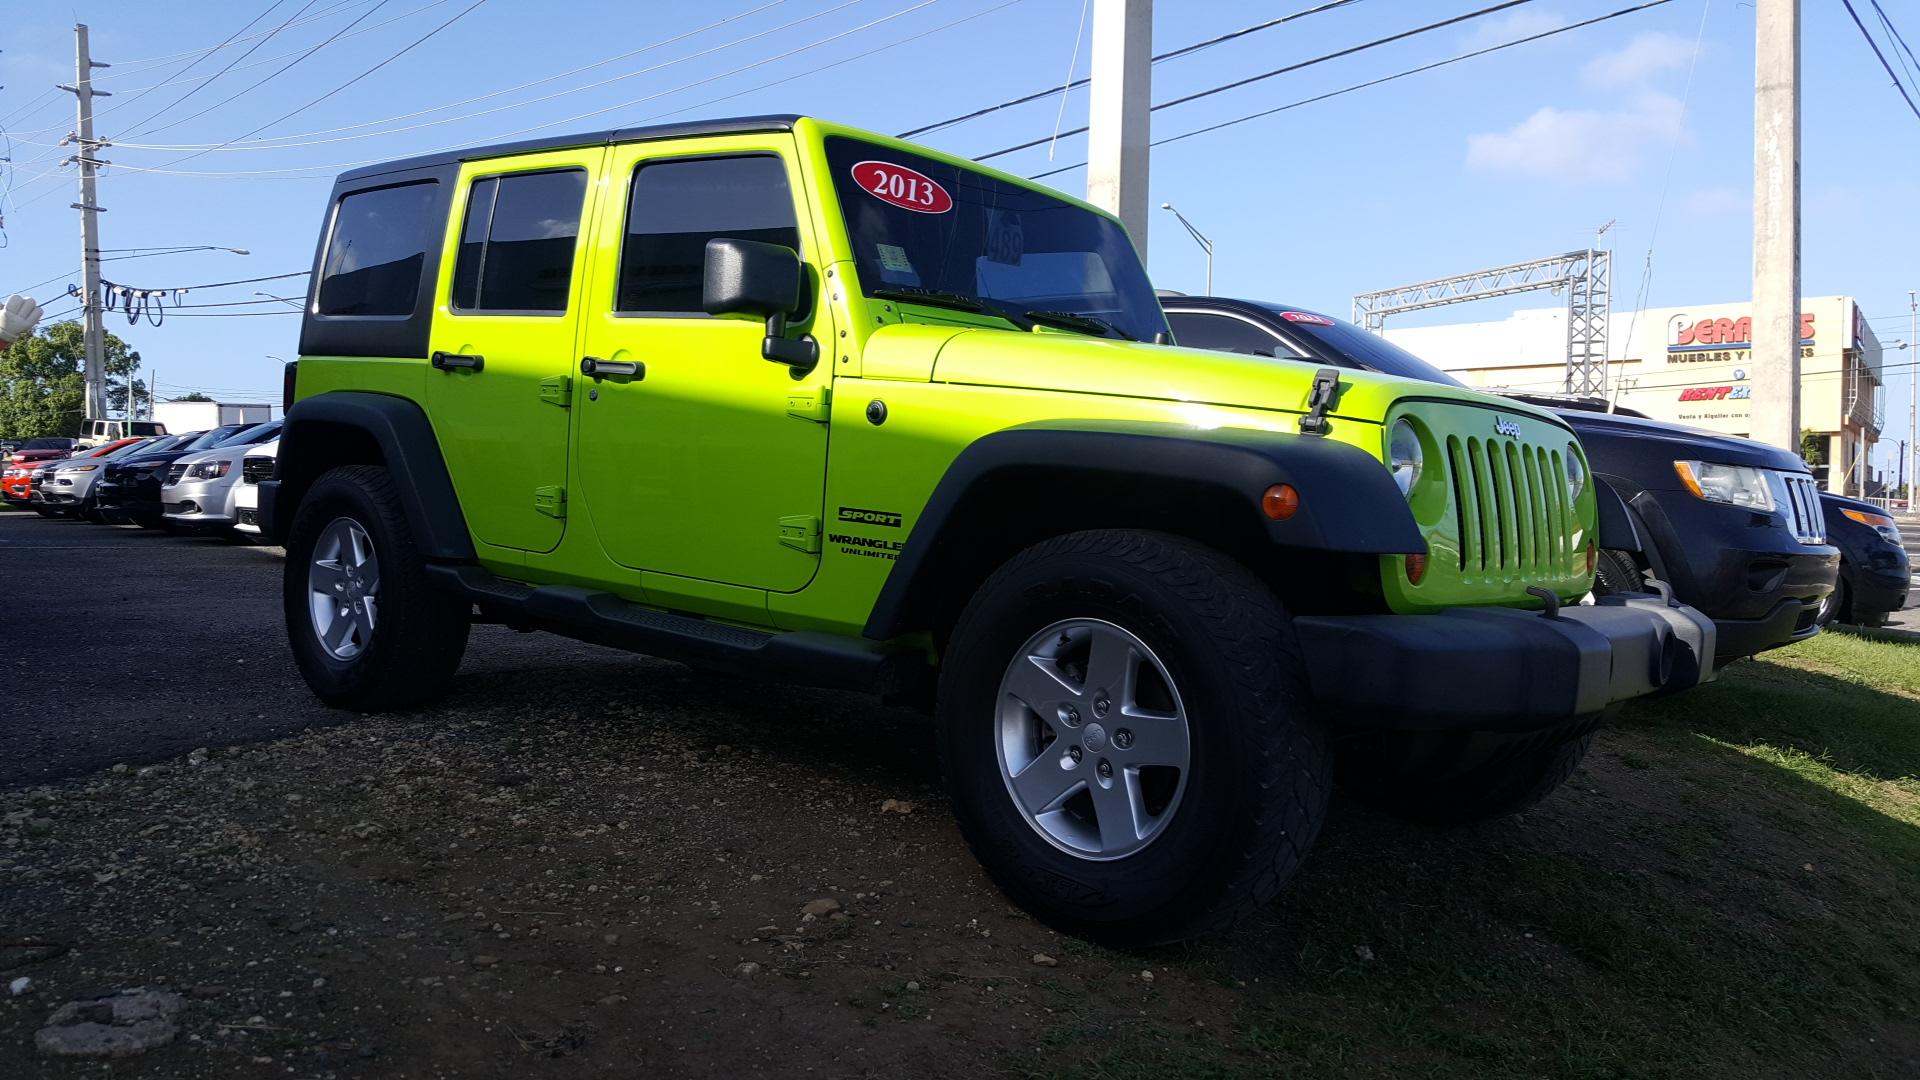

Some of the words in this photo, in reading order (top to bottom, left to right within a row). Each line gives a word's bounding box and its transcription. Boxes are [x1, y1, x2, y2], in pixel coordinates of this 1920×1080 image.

[873, 170, 934, 206] 2013
[1668, 313, 1815, 346] BERRS
[1667, 352, 1731, 363] MUEBLES
[1736, 351, 1744, 361] Y
[1495, 415, 1520, 440] Jeep
[841, 510, 898, 524] SPORT
[829, 534, 904, 551] WRANGLE
